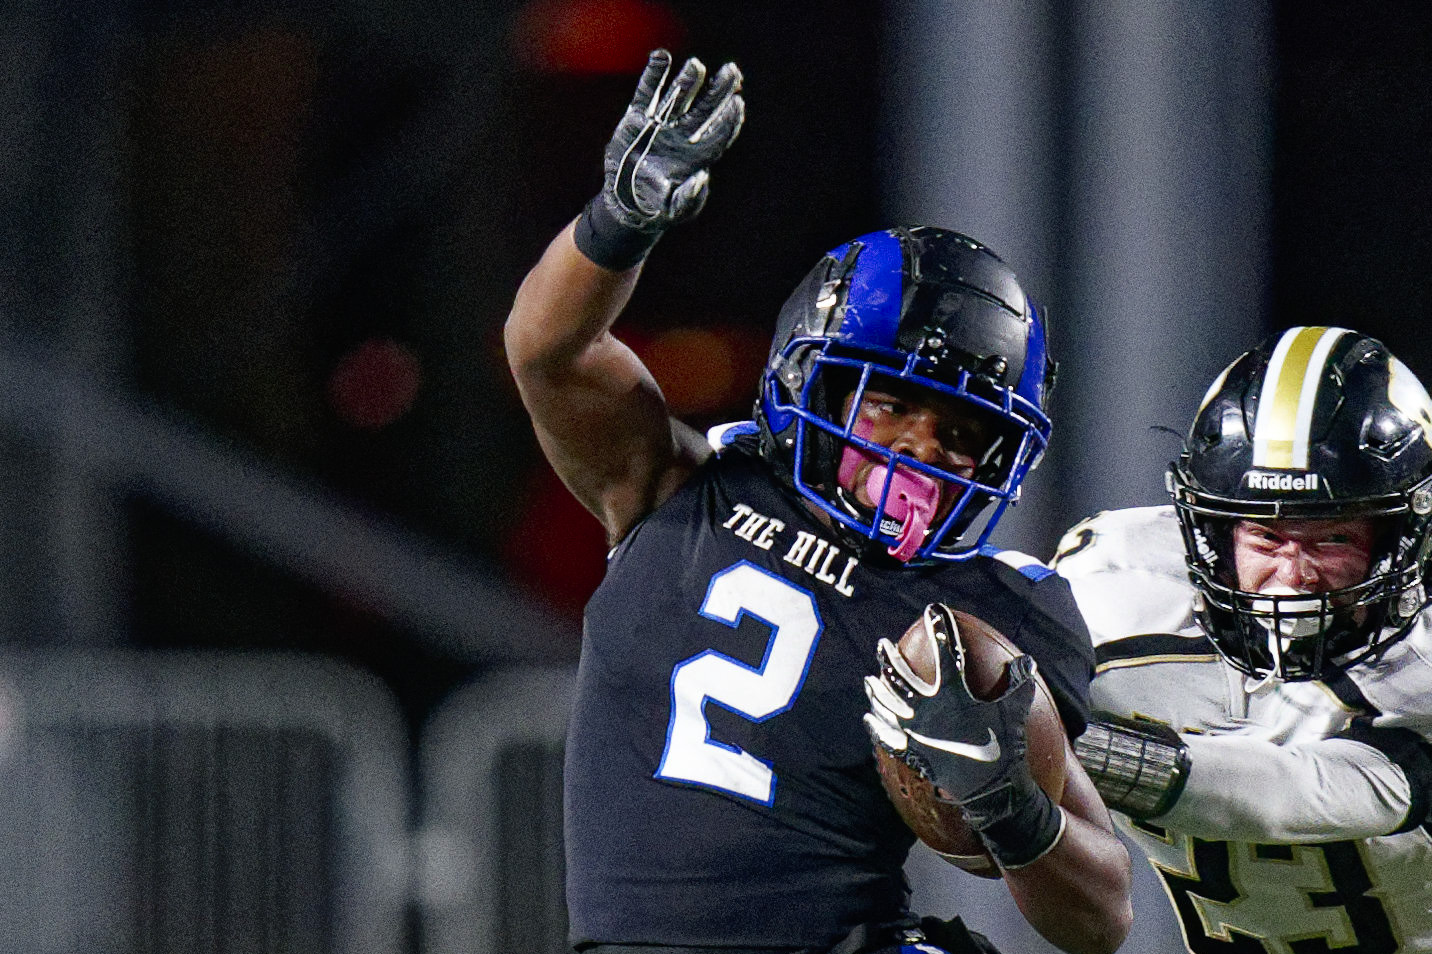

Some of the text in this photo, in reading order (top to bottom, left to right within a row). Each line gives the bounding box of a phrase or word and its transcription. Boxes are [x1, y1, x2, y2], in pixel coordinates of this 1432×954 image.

[1247, 471, 1318, 491] Riddell
[722, 503, 859, 597] THE HILL
[654, 558, 825, 809] 2
